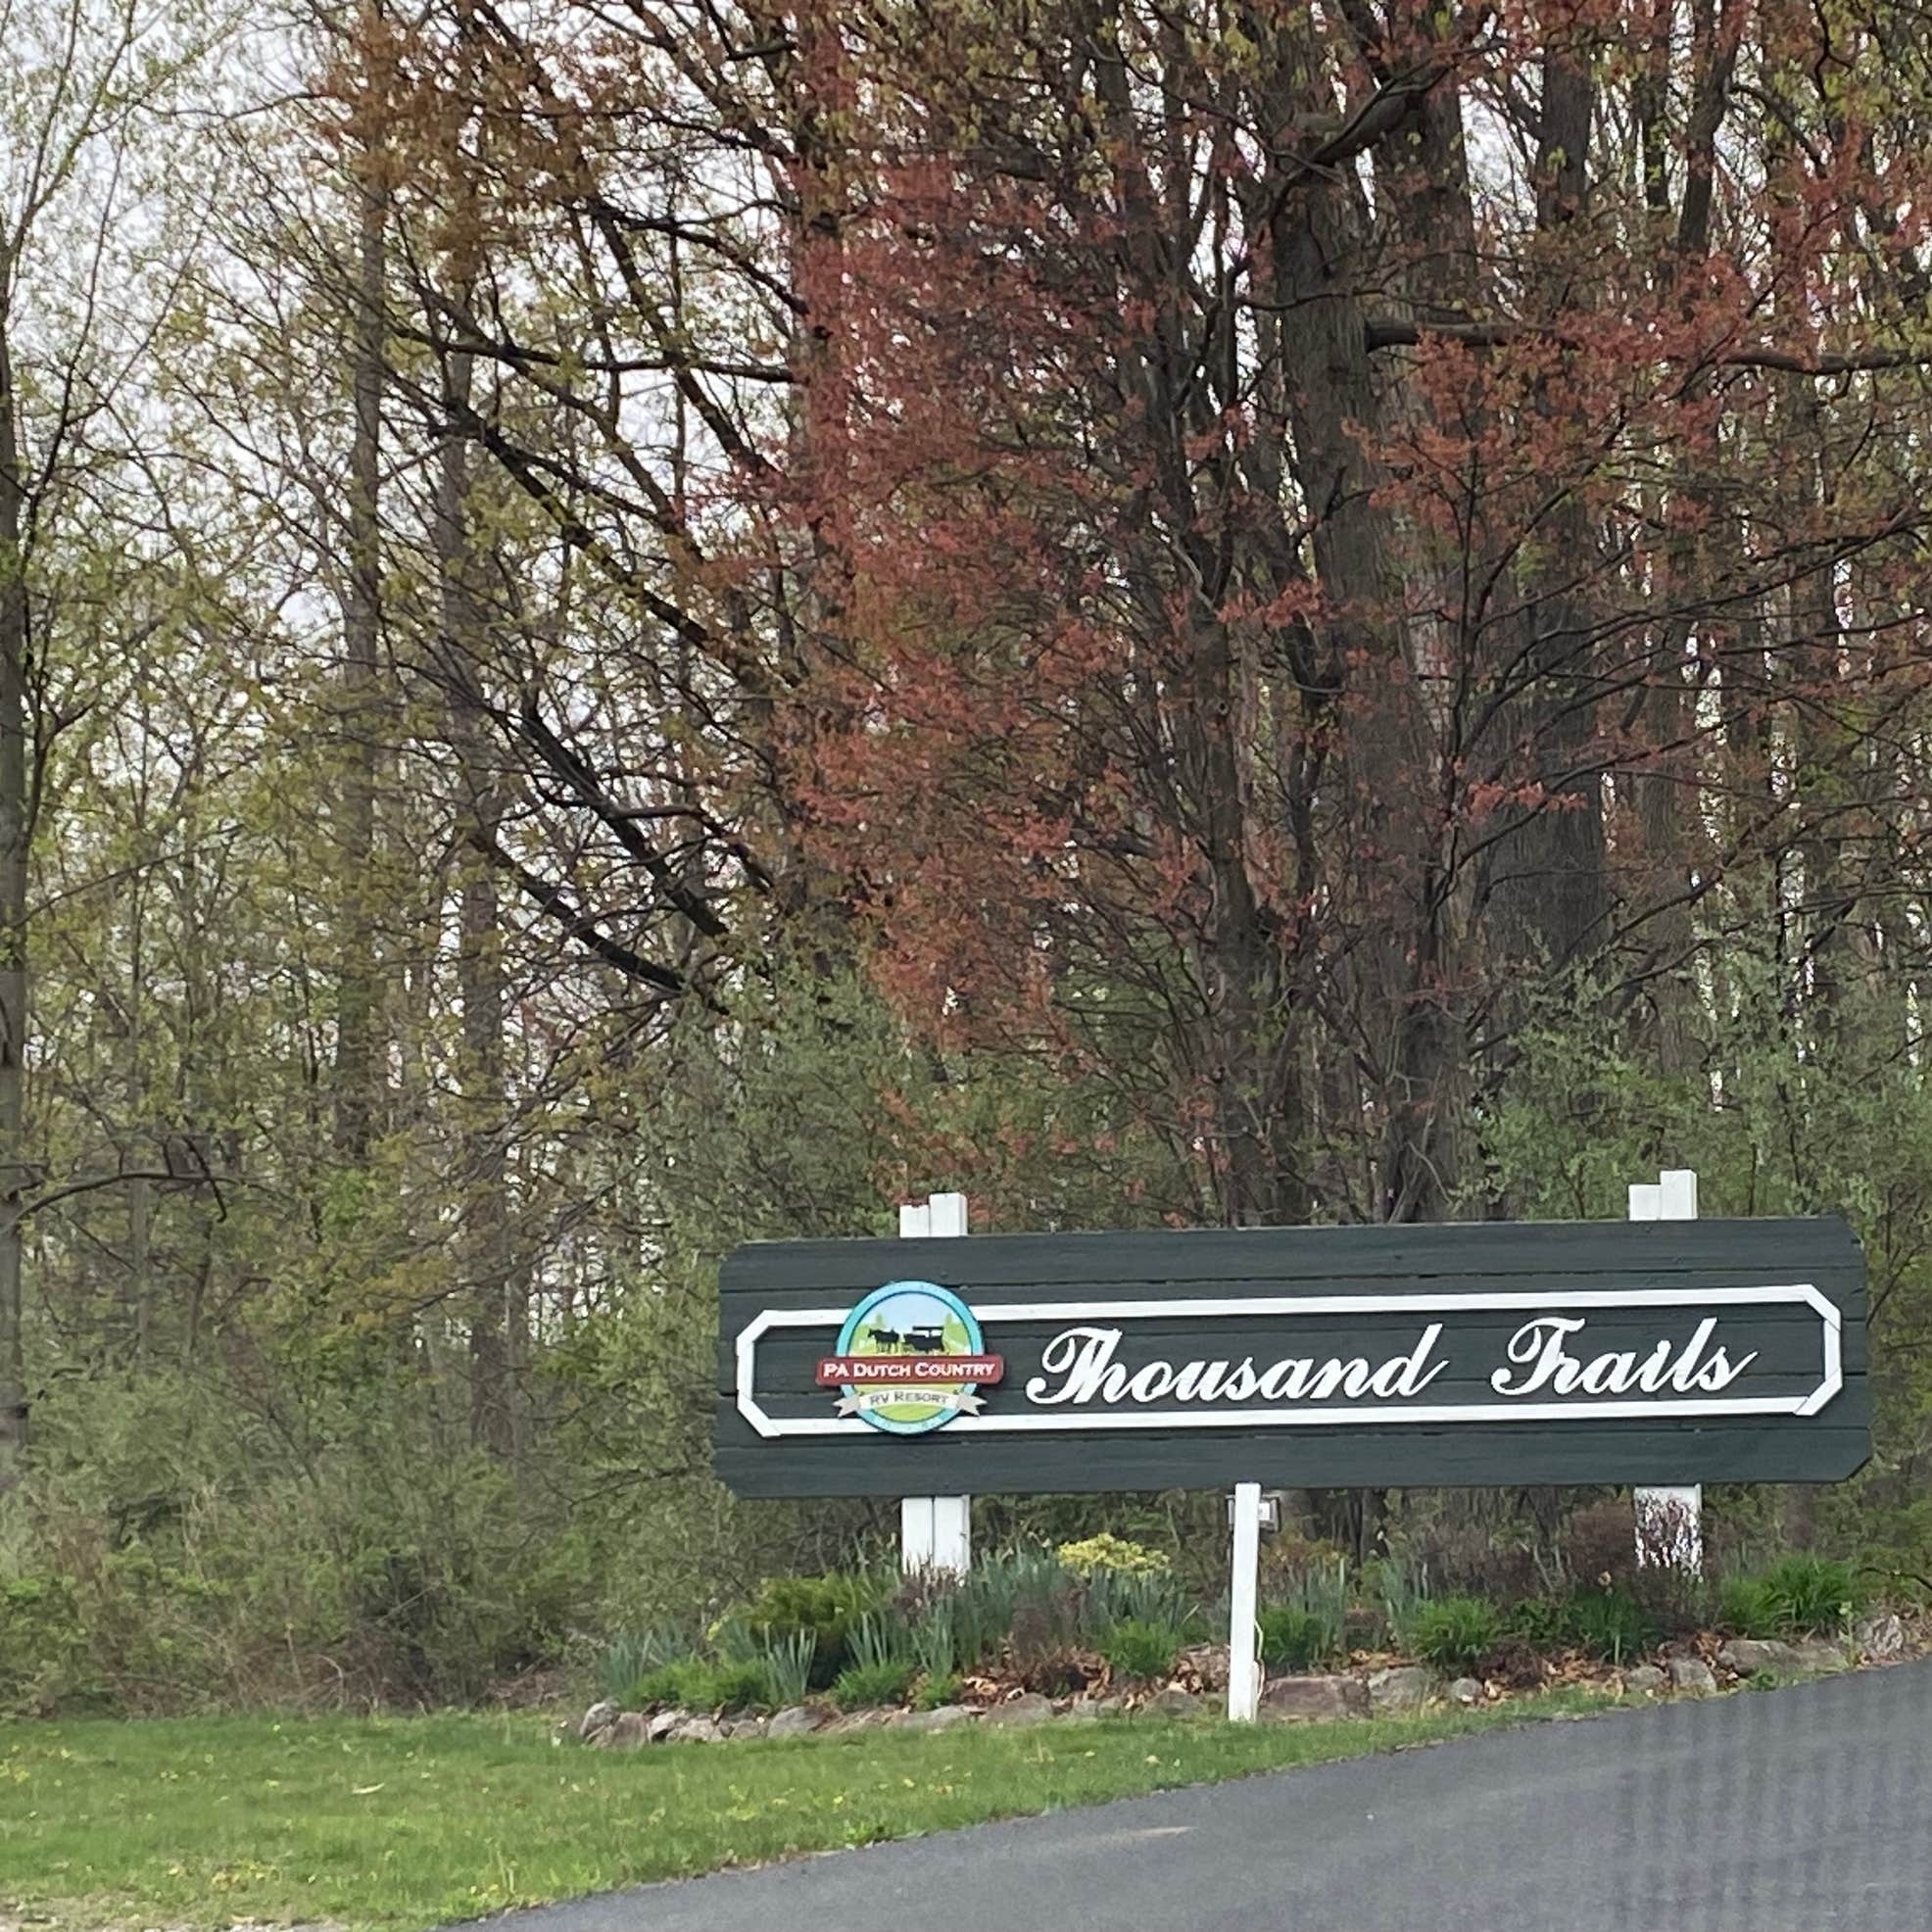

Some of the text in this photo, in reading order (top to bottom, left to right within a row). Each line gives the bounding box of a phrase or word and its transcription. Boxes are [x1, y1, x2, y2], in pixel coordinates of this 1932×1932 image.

[1025, 1317, 1760, 1405] Thousand Trails
[822, 1362, 995, 1377] PA DUTCH COUNTRY
[869, 1390, 949, 1405] RV RESORT
